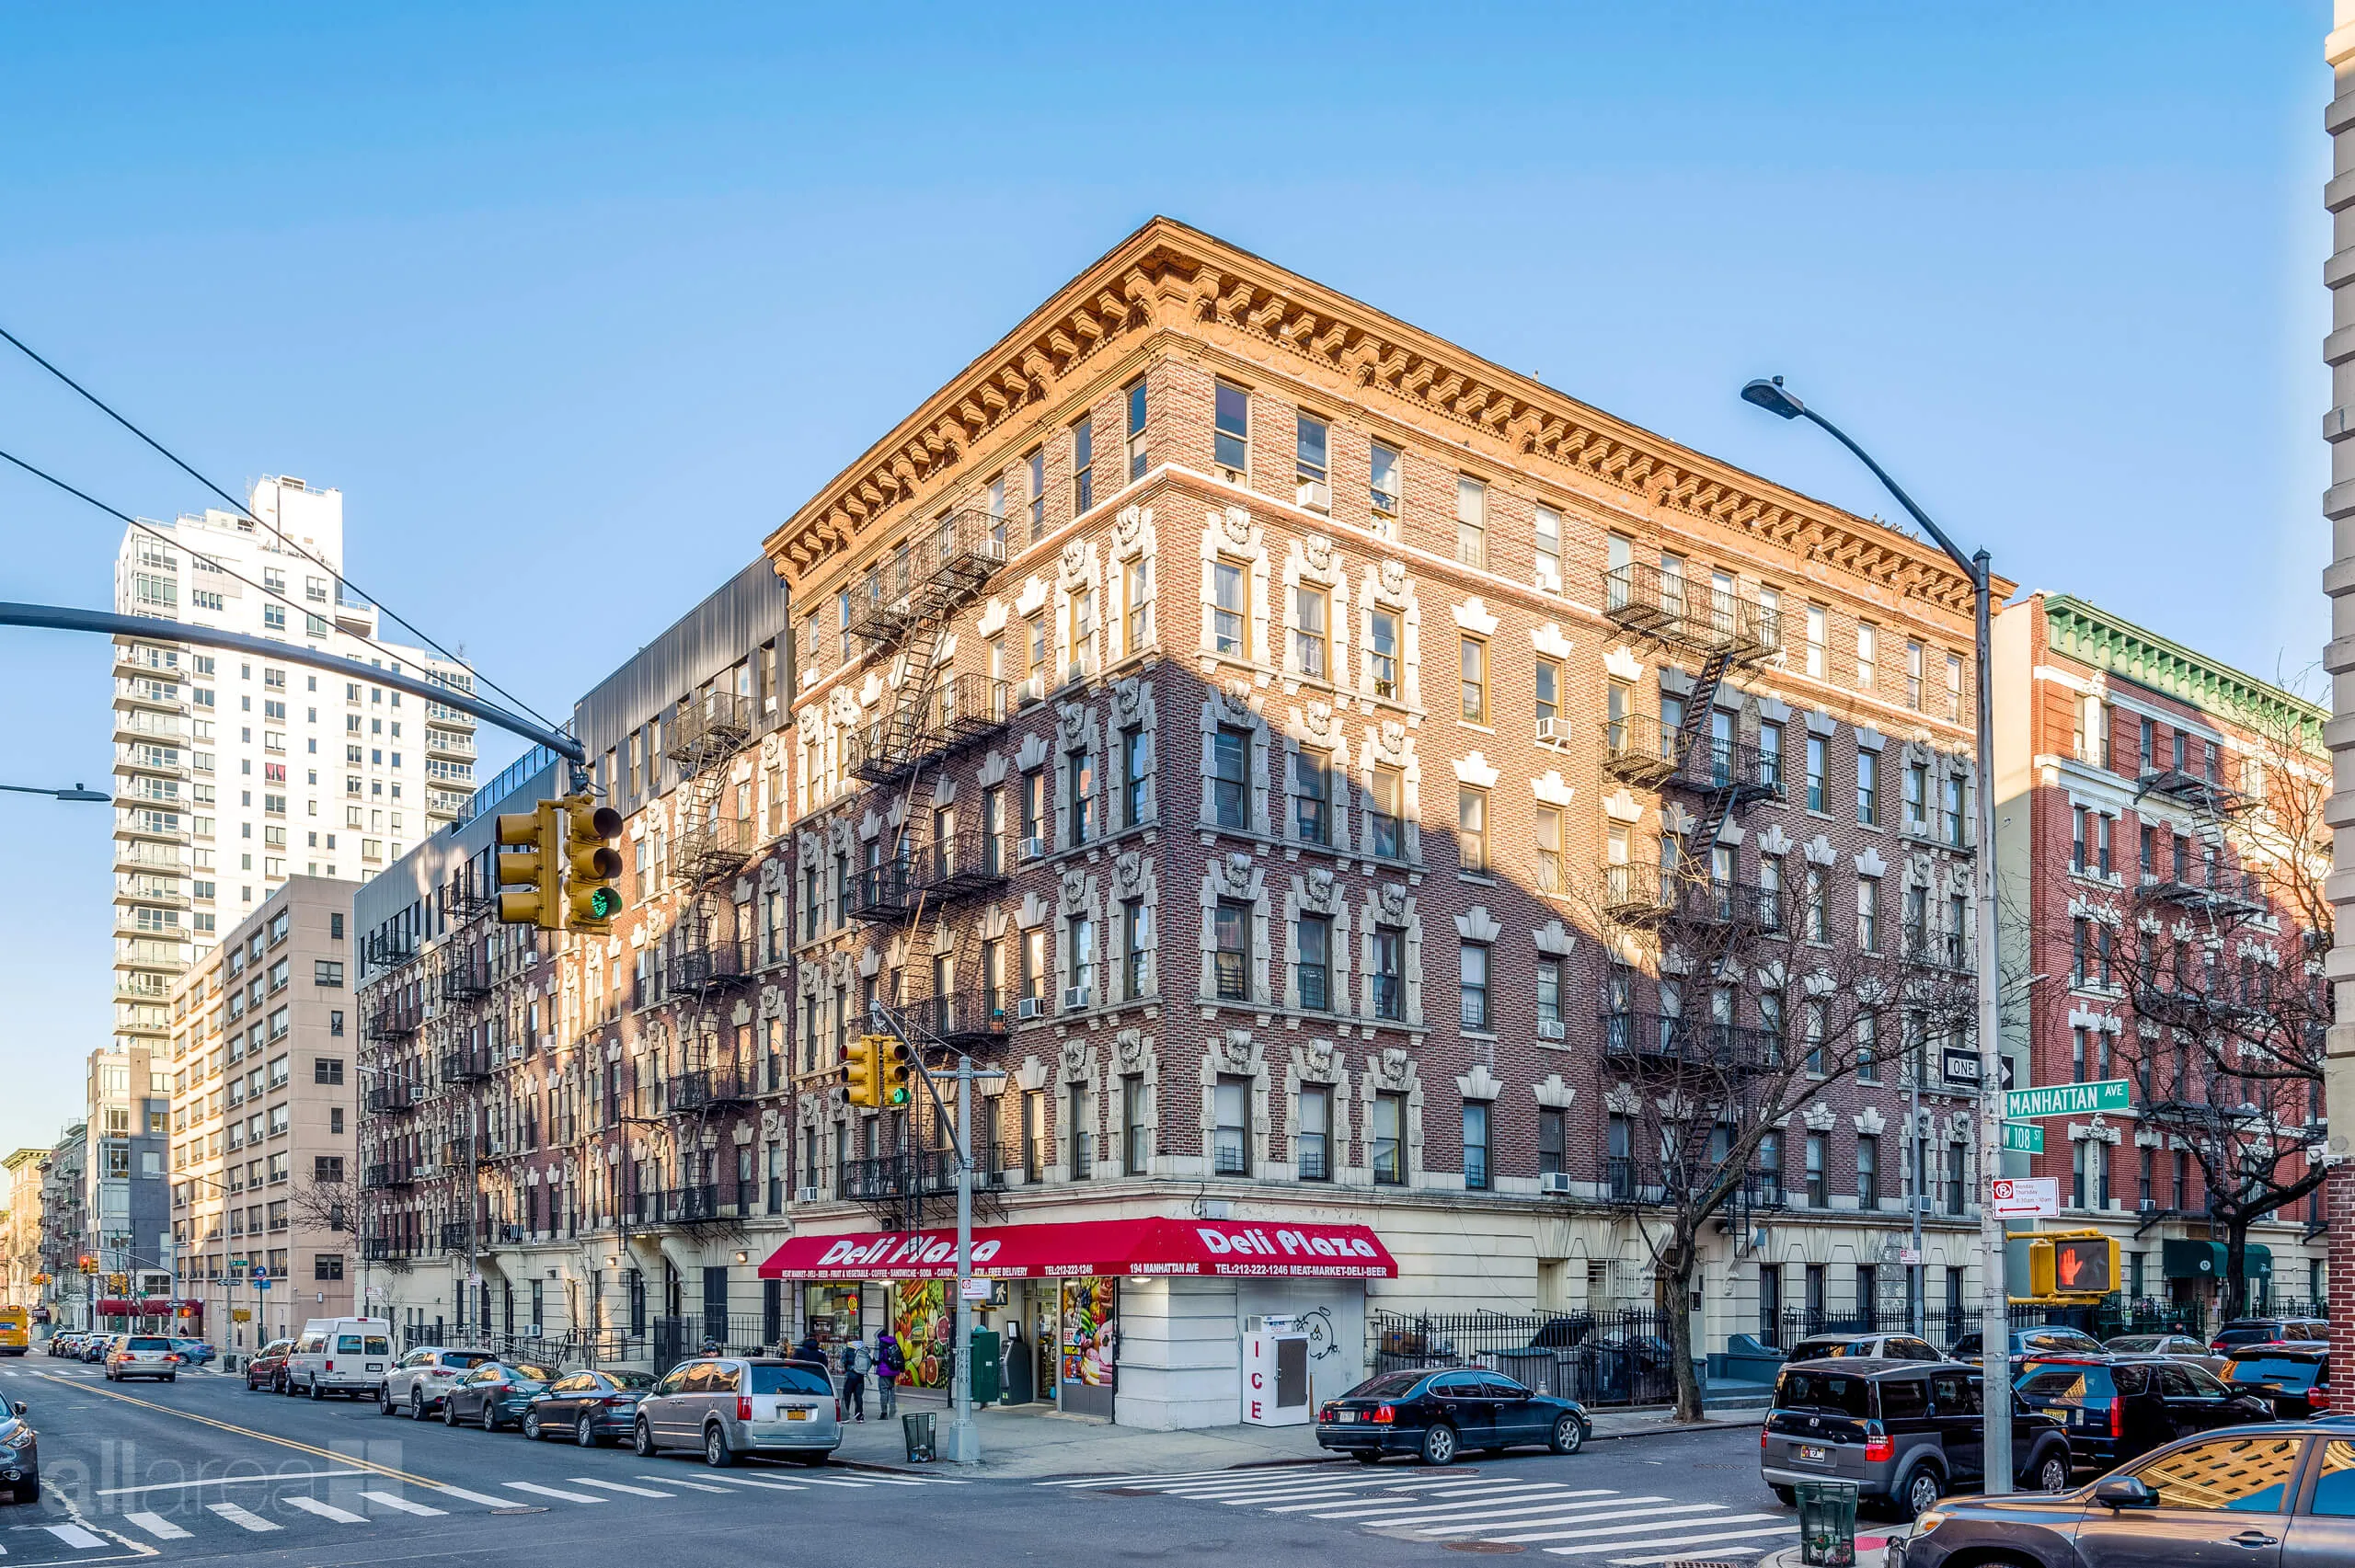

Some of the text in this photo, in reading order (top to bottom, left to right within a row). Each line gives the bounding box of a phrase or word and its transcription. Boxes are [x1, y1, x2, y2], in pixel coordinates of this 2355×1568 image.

[1953, 1059, 1975, 1076] ONE
[2009, 1084, 2124, 1116] MANHATTAN AVE
[2015, 1127, 2031, 1150] 108
[2034, 1130, 2041, 1141] ST
[816, 1234, 1002, 1265] Deli Plaza
[1196, 1228, 1378, 1258] Deli Plaza
[988, 1267, 1002, 1276] FREE
[1002, 1266, 1028, 1276] DELIVERY
[1129, 1263, 1200, 1274] 194 MANHATTAN AVE
[1215, 1264, 1289, 1275] TEL:212-222-1246
[1251, 1340, 1263, 1420] ICE
